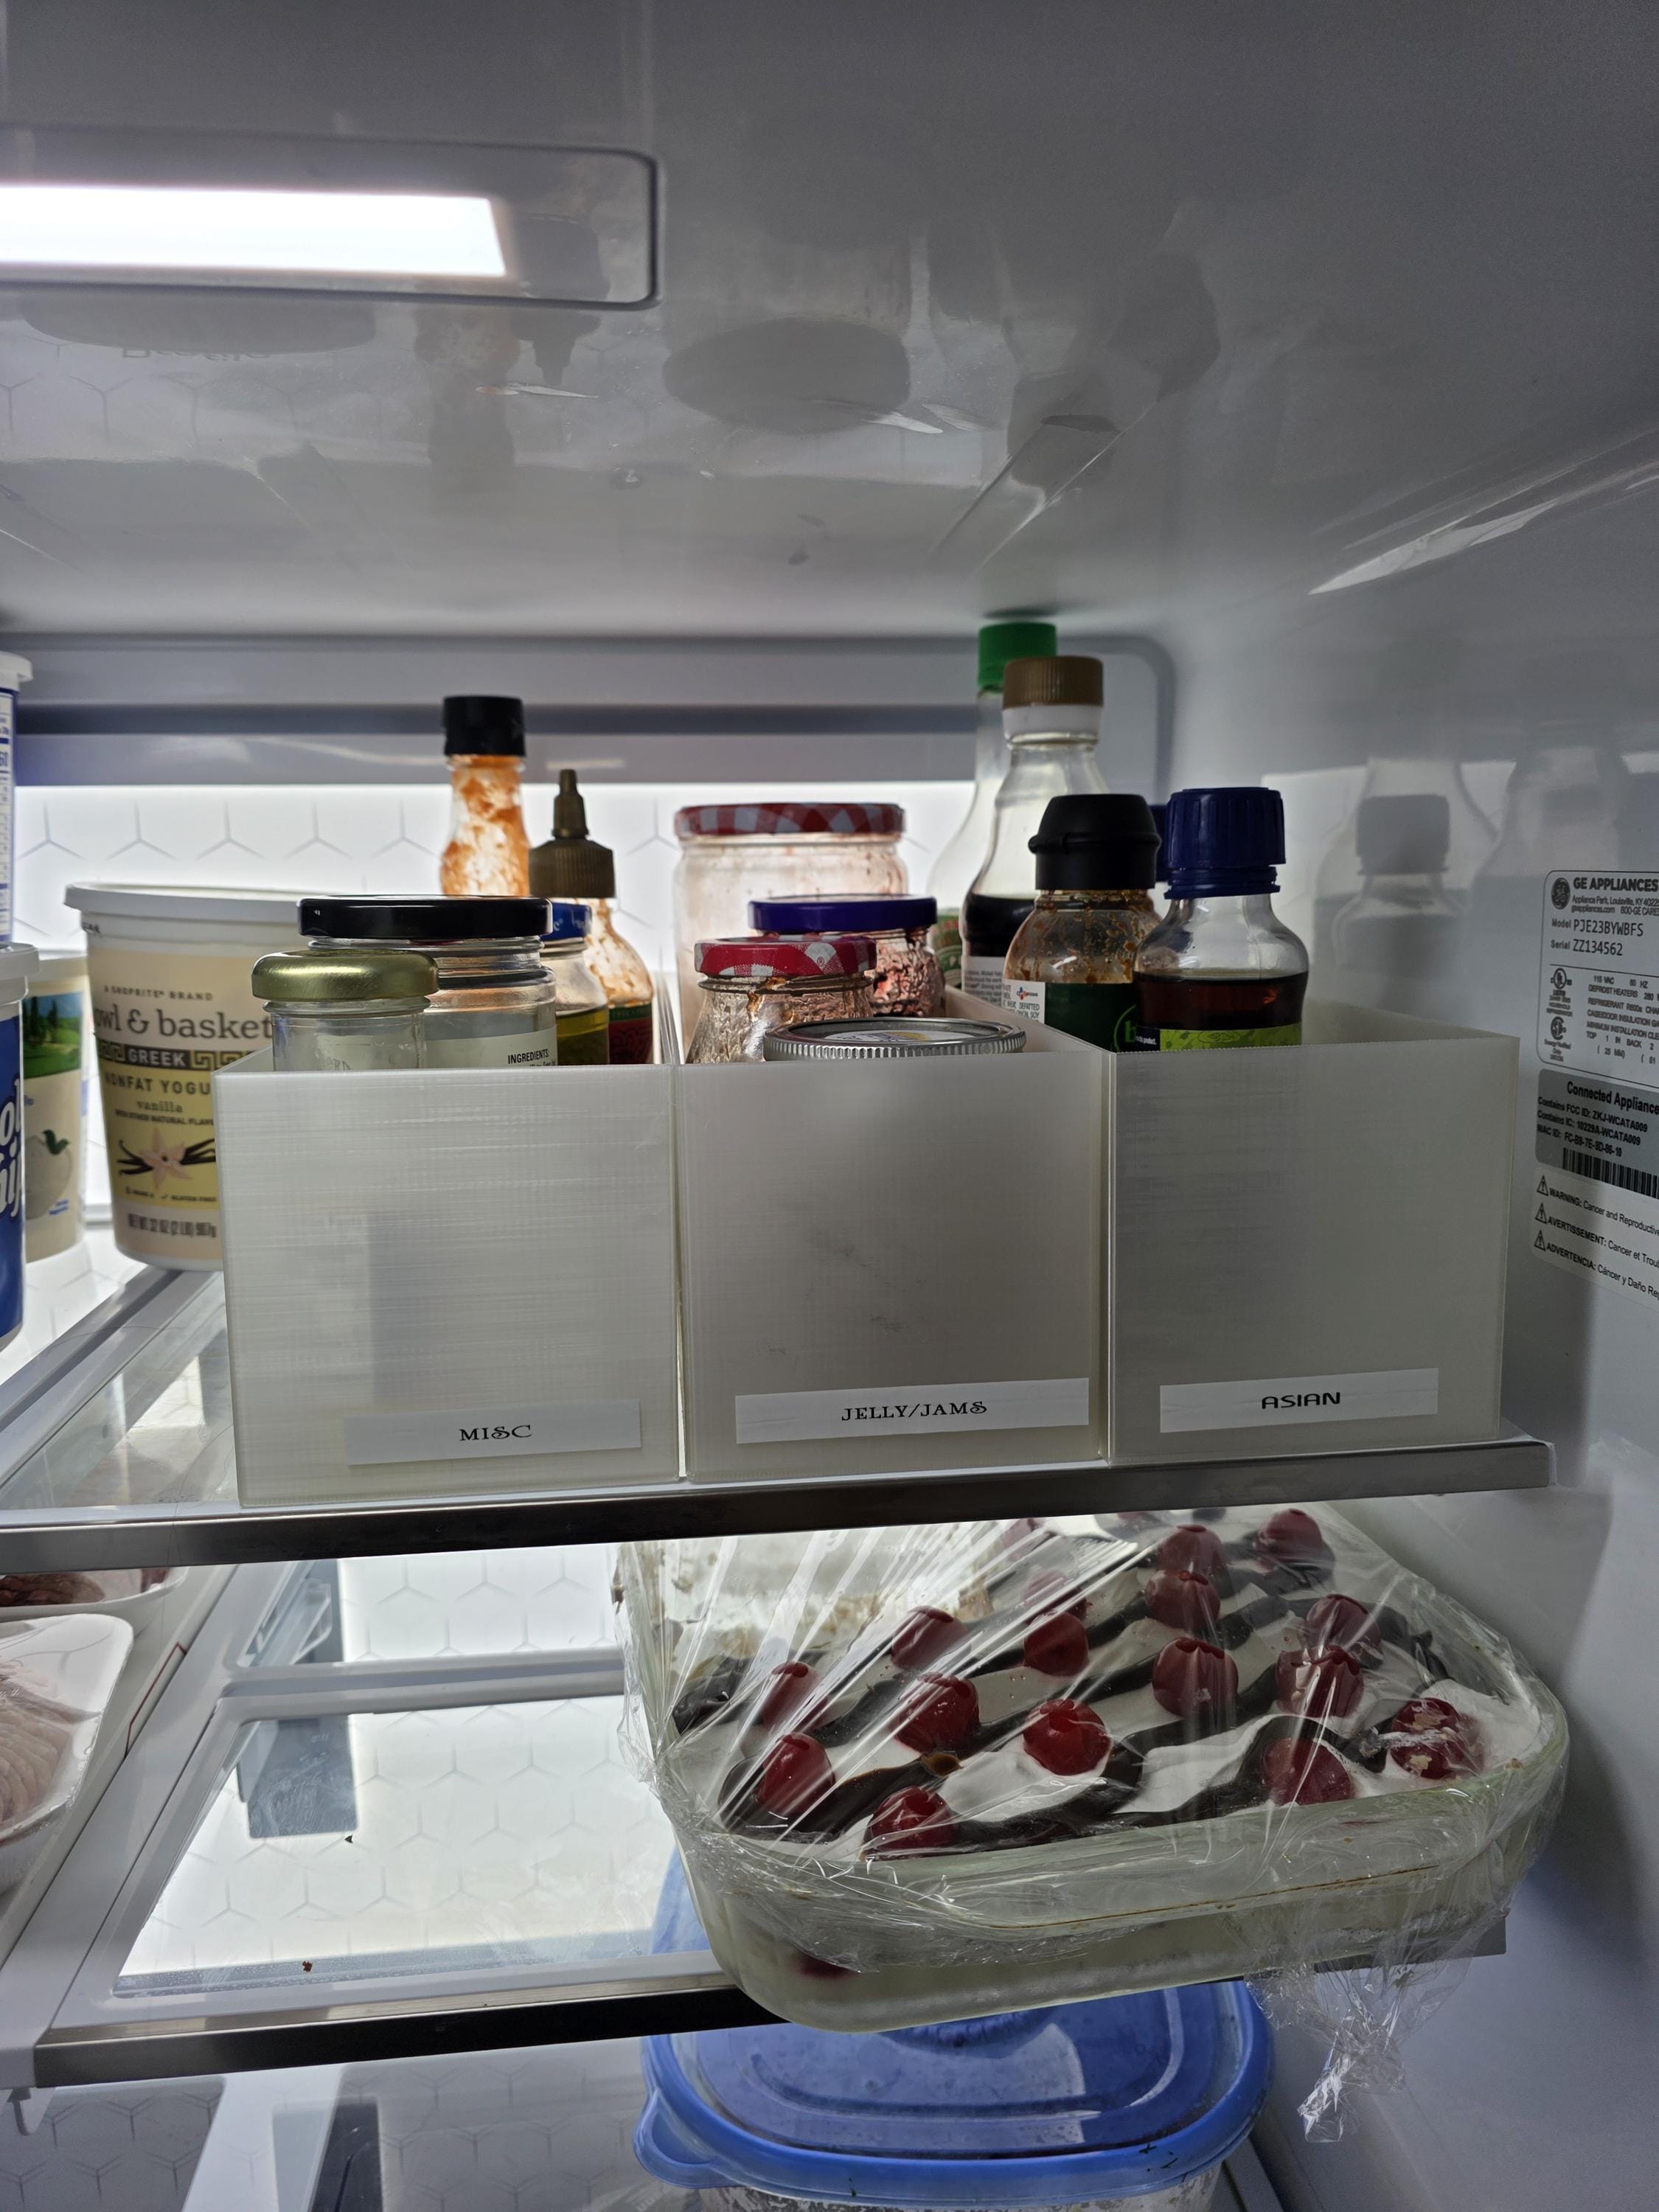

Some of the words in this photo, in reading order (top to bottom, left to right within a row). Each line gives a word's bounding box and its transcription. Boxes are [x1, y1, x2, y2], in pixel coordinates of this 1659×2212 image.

[1573, 877, 1587, 889] GE
[1589, 877, 1659, 892] APPLIANCES
[1635, 897, 1644, 906] KY
[1551, 918, 1572, 928] Model
[1551, 939, 1571, 950] Serial
[1573, 939, 1623, 956] ZZ134562
[1604, 976, 1615, 985] VAC
[1640, 980, 1649, 989] HZ
[169, 992, 212, 1001] BRAND
[1588, 984, 1613, 995] DEFROST
[1613, 988, 1638, 998] HEATERS
[1018, 1003, 1040, 1011] DEFATTED
[1587, 997, 1624, 1009] REFRIGERANT
[94, 1004, 122, 1032] owl
[127, 1009, 150, 1034] &
[156, 1009, 273, 1040] basket
[1618, 1014, 1651, 1027] INSULATION
[1610, 1024, 1647, 1038] INSTALLATION
[1586, 1031, 1597, 1039] TOP
[1627, 1038, 1642, 1048] BACK
[1649, 1043, 1654, 1051] 2
[128, 1048, 187, 1067] GREEK
[105, 1072, 153, 1092] NONFAT
[161, 1082, 211, 1096] YOGU
[1567, 1081, 1613, 1104] Connected
[136, 1100, 184, 1113] vanilla
[1537, 1096, 1565, 1110] Contains
[1566, 1104, 1580, 1115] FCC
[1582, 1107, 1591, 1118] ID:
[1592, 1110, 1648, 1133] ZKJ-WCATA009
[1537, 1110, 1565, 1124] Contains
[1565, 1117, 1575, 1127] IC:
[1537, 1123, 1551, 1135] MAC
[1552, 1128, 1562, 1138] ID:
[1549, 1188, 1582, 1207] WARNING:
[1583, 1200, 1605, 1215] Cancer
[1606, 1211, 1618, 1220] and
[1548, 1216, 1607, 1247] AVERTISSEMENT:
[1608, 1240, 1632, 1257] Cancer
[1633, 1252, 1641, 1261] et
[1546, 1242, 1596, 1270] ADVERTENCIA:
[1597, 1264, 1621, 1281] Cáncer
[1622, 1276, 1627, 1286] y
[1628, 1276, 1646, 1293] Daño
[1262, 1392, 1340, 1409] ASIAN
[841, 1401, 987, 1422] JELLY/JAMS
[459, 1425, 532, 1441] MISC
